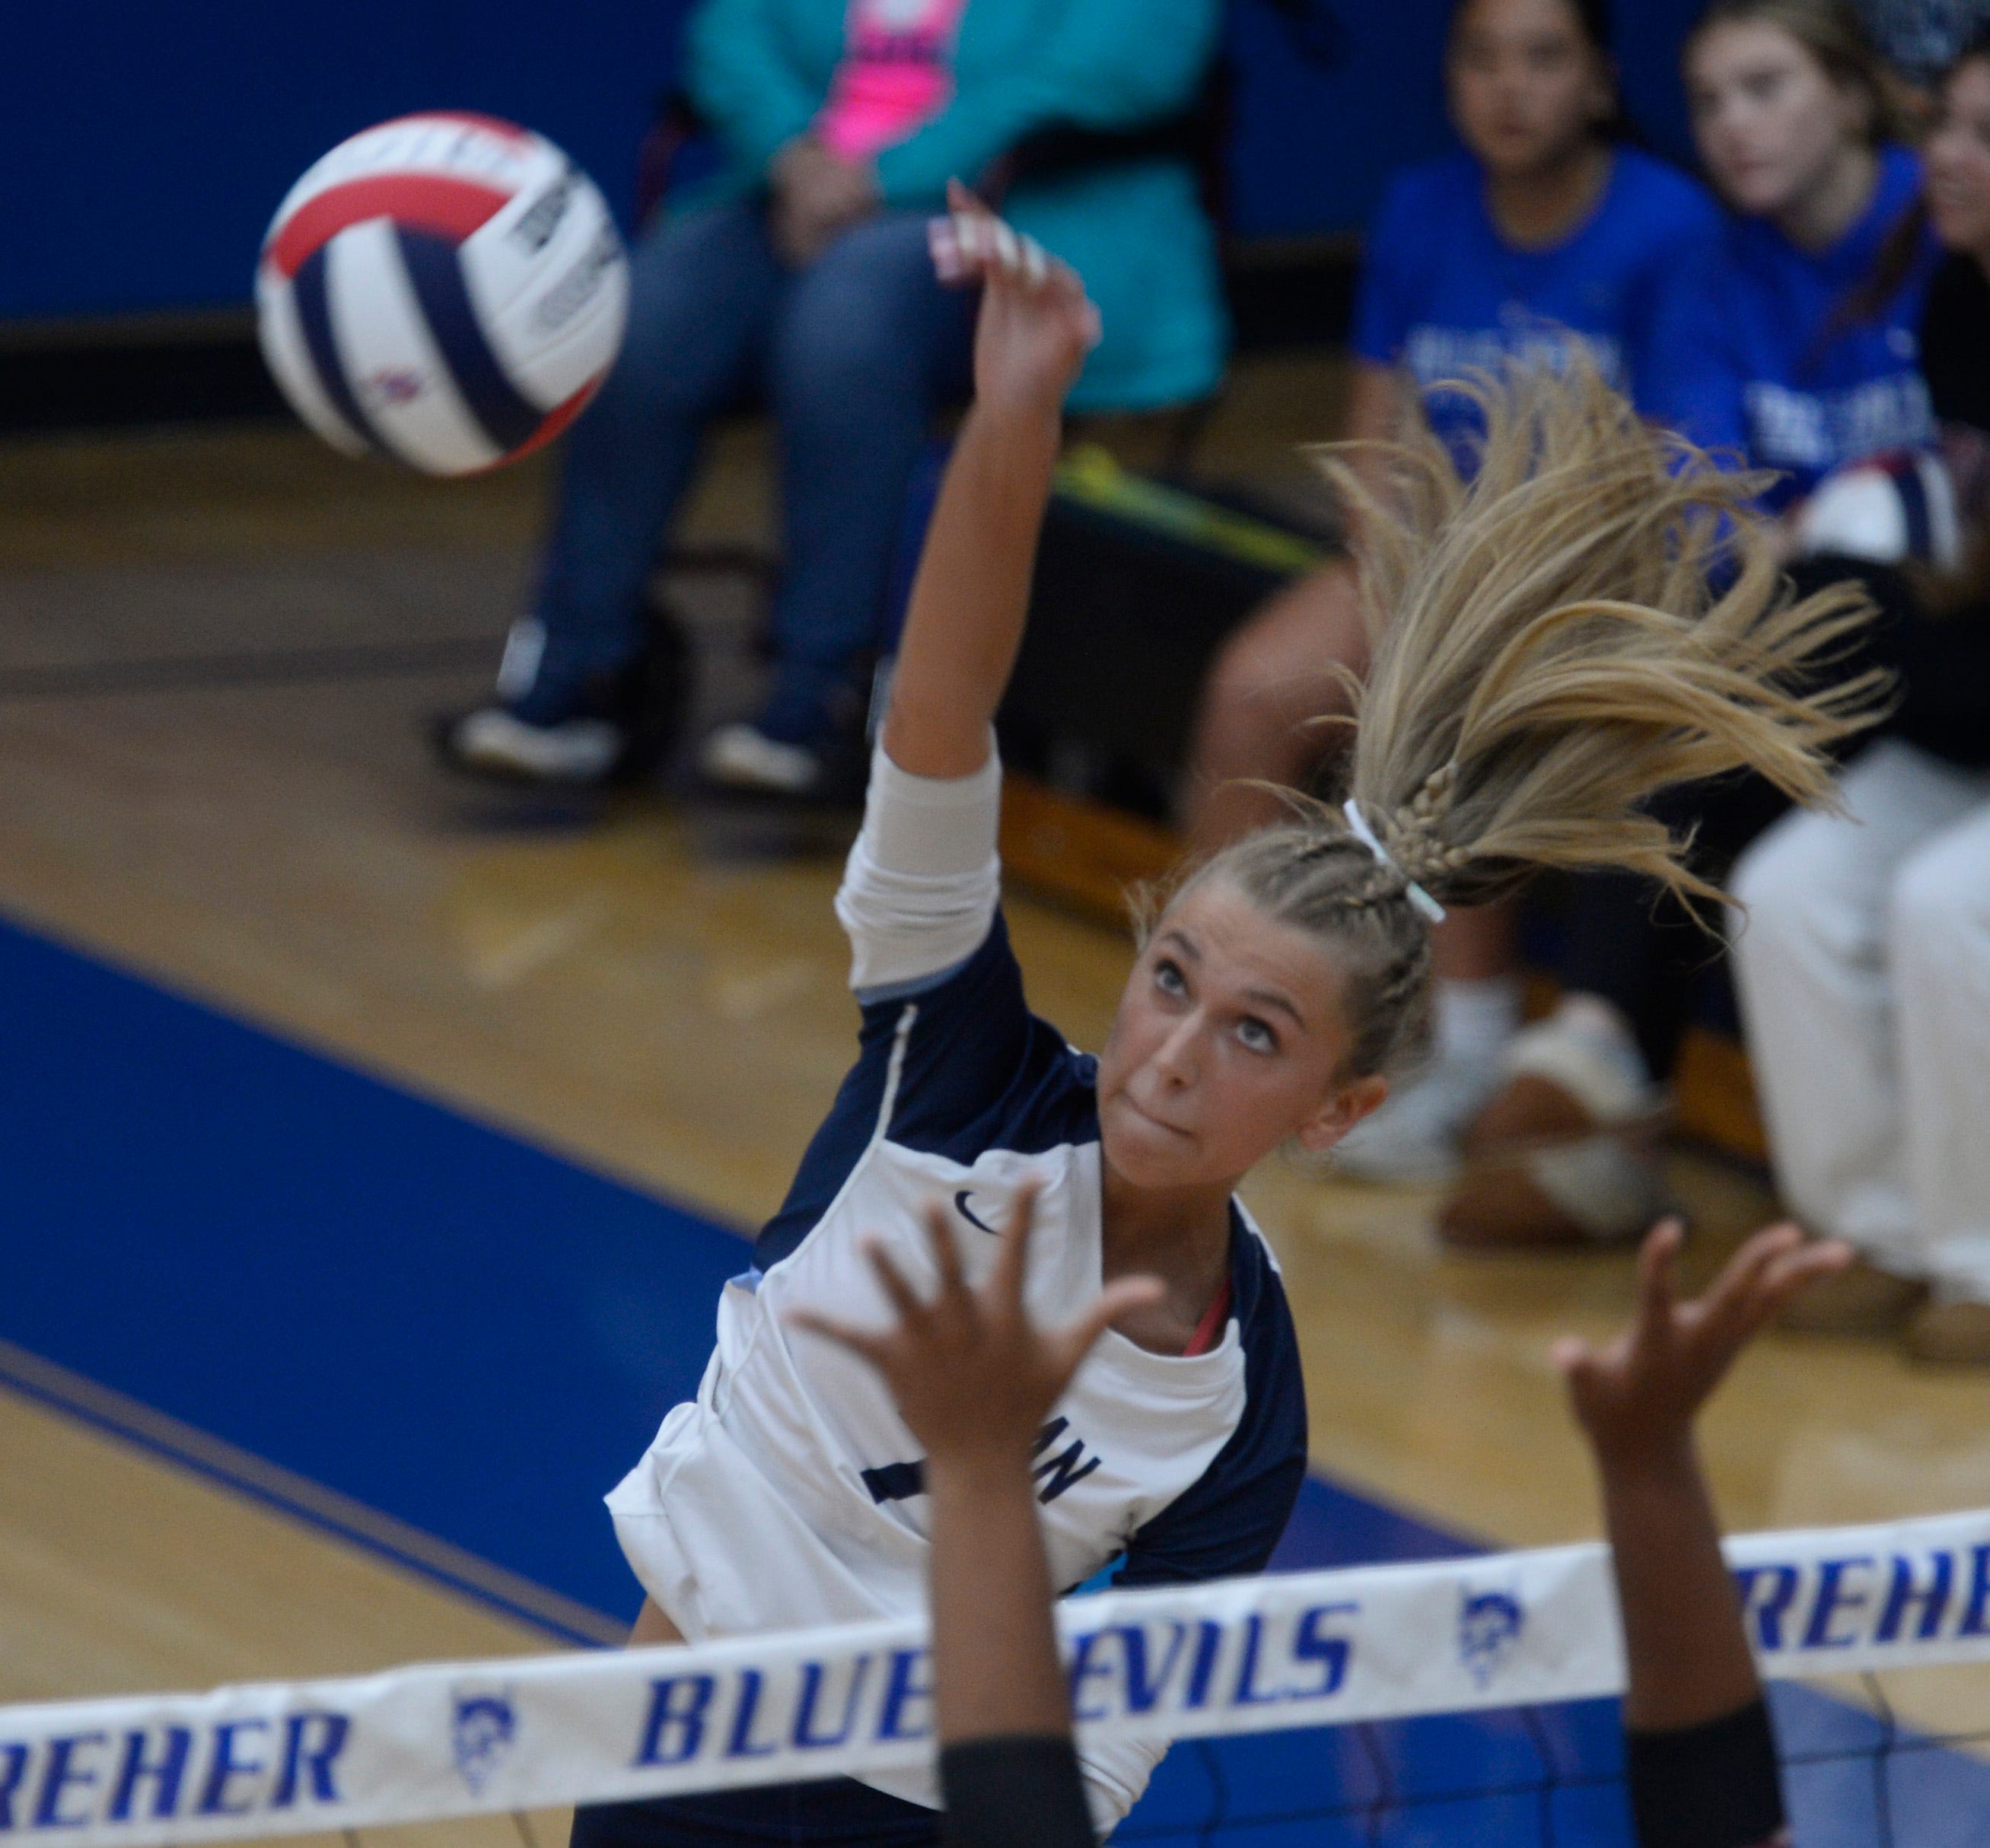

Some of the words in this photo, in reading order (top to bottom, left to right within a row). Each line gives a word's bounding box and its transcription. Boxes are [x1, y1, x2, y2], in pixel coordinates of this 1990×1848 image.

[1731, 1542, 1990, 1652] REH
[631, 1649, 933, 1767] BLUE
[1069, 1602, 1359, 1722] EVILS
